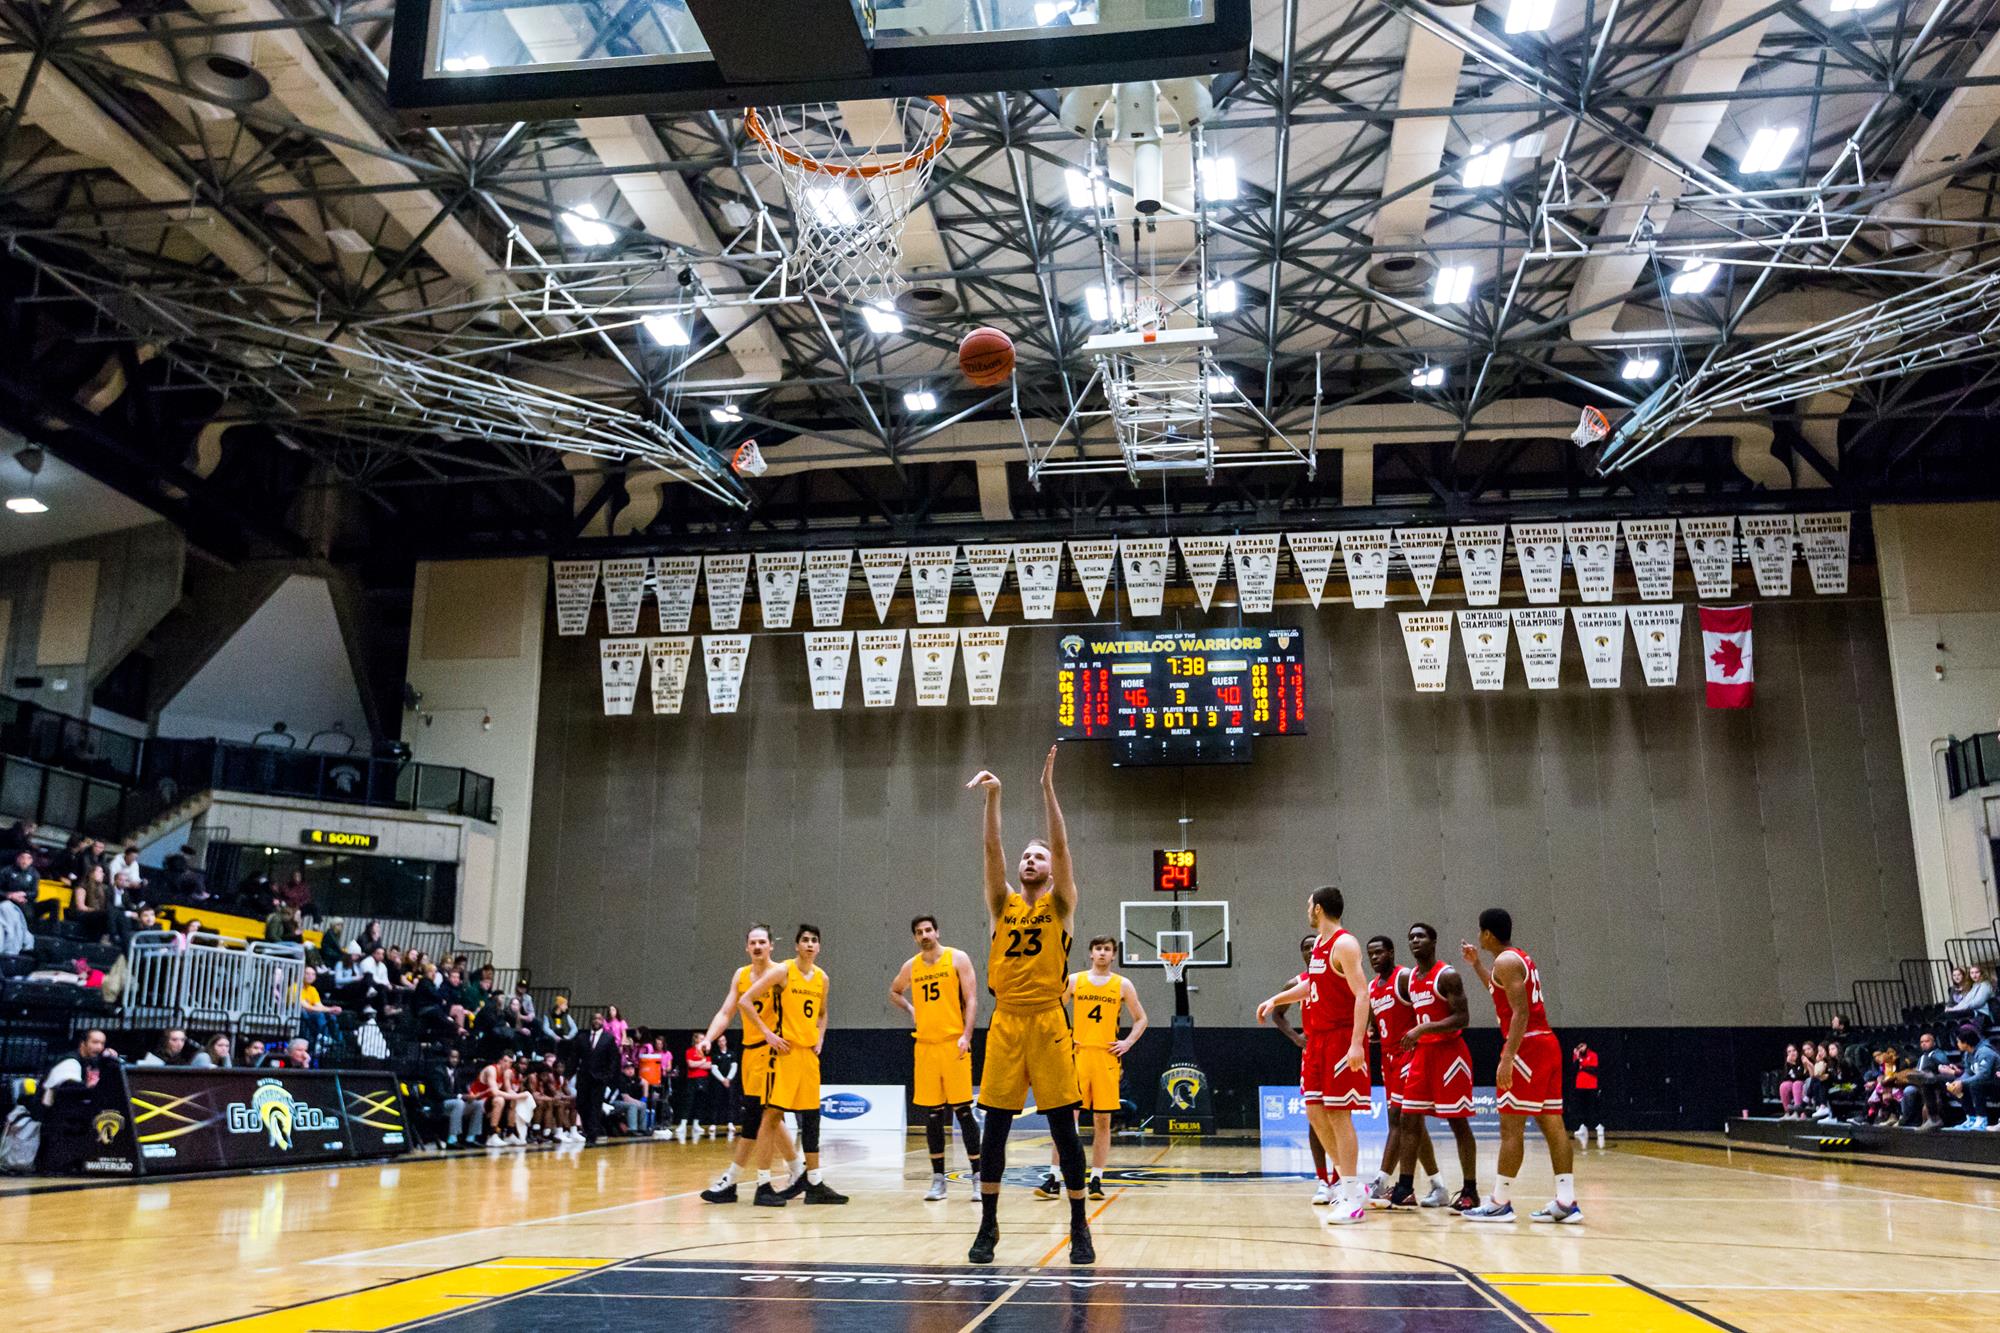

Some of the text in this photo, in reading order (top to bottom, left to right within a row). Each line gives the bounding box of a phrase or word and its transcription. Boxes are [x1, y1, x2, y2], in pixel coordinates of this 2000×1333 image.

[1688, 522, 1727, 530] ONTARIO
[1804, 517, 1842, 525] ONTARIO
[1572, 526, 1610, 534] ONTARIO
[1630, 524, 1669, 532] ONTARIO
[1746, 528, 1791, 536] CHAMPIONS
[1628, 532, 1673, 540] CHAMPIONS
[1686, 530, 1731, 538] CHAMPIONS
[1293, 536, 1333, 544] NATIONAL
[1402, 540, 1443, 548] CHAMPIONS
[1516, 536, 1562, 544] CHAMPIONS
[1461, 620, 1507, 628] CHAMPIONS
[1515, 619, 1563, 627] CHAMPIONS
[1634, 618, 1679, 626] CHAMPIONS
[1405, 624, 1449, 632] CHAMPIONS
[1091, 637, 1262, 654] WATERLOO WARRIORS
[1167, 657, 1205, 675] 7:38
[1252, 665, 1267, 676] 03
[1276, 664, 1284, 675] 0
[1059, 670, 1074, 681] 04
[1212, 677, 1238, 685] GUEST
[1059, 681, 1074, 693] 06
[1121, 679, 1144, 688] HOME
[1124, 688, 1148, 707] 46
[1176, 690, 1185, 704] 3
[1217, 686, 1240, 704] 40
[1059, 704, 1074, 715] 23
[1145, 713, 1155, 728] 3
[1164, 713, 1197, 727] 07 1
[1208, 712, 1217, 727] 3
[1232, 711, 1242, 726] 2
[1254, 710, 1269, 721] 23
[1129, 715, 1135, 728] 1
[329, 833, 370, 846] SOUTH
[1166, 852, 1194, 866] 7:38
[1162, 866, 1189, 888] 24
[1004, 914, 1052, 925] WARIORS
[1005, 928, 1042, 957] 23
[914, 972, 949, 983] WARRIORS
[922, 982, 940, 1002] 15
[1078, 995, 1116, 1004] WARRIORS
[804, 1000, 814, 1018] 6
[1088, 1005, 1102, 1023] 4
[1379, 1018, 1388, 1038] 3
[86, 1161, 134, 1172] WATERLOO
